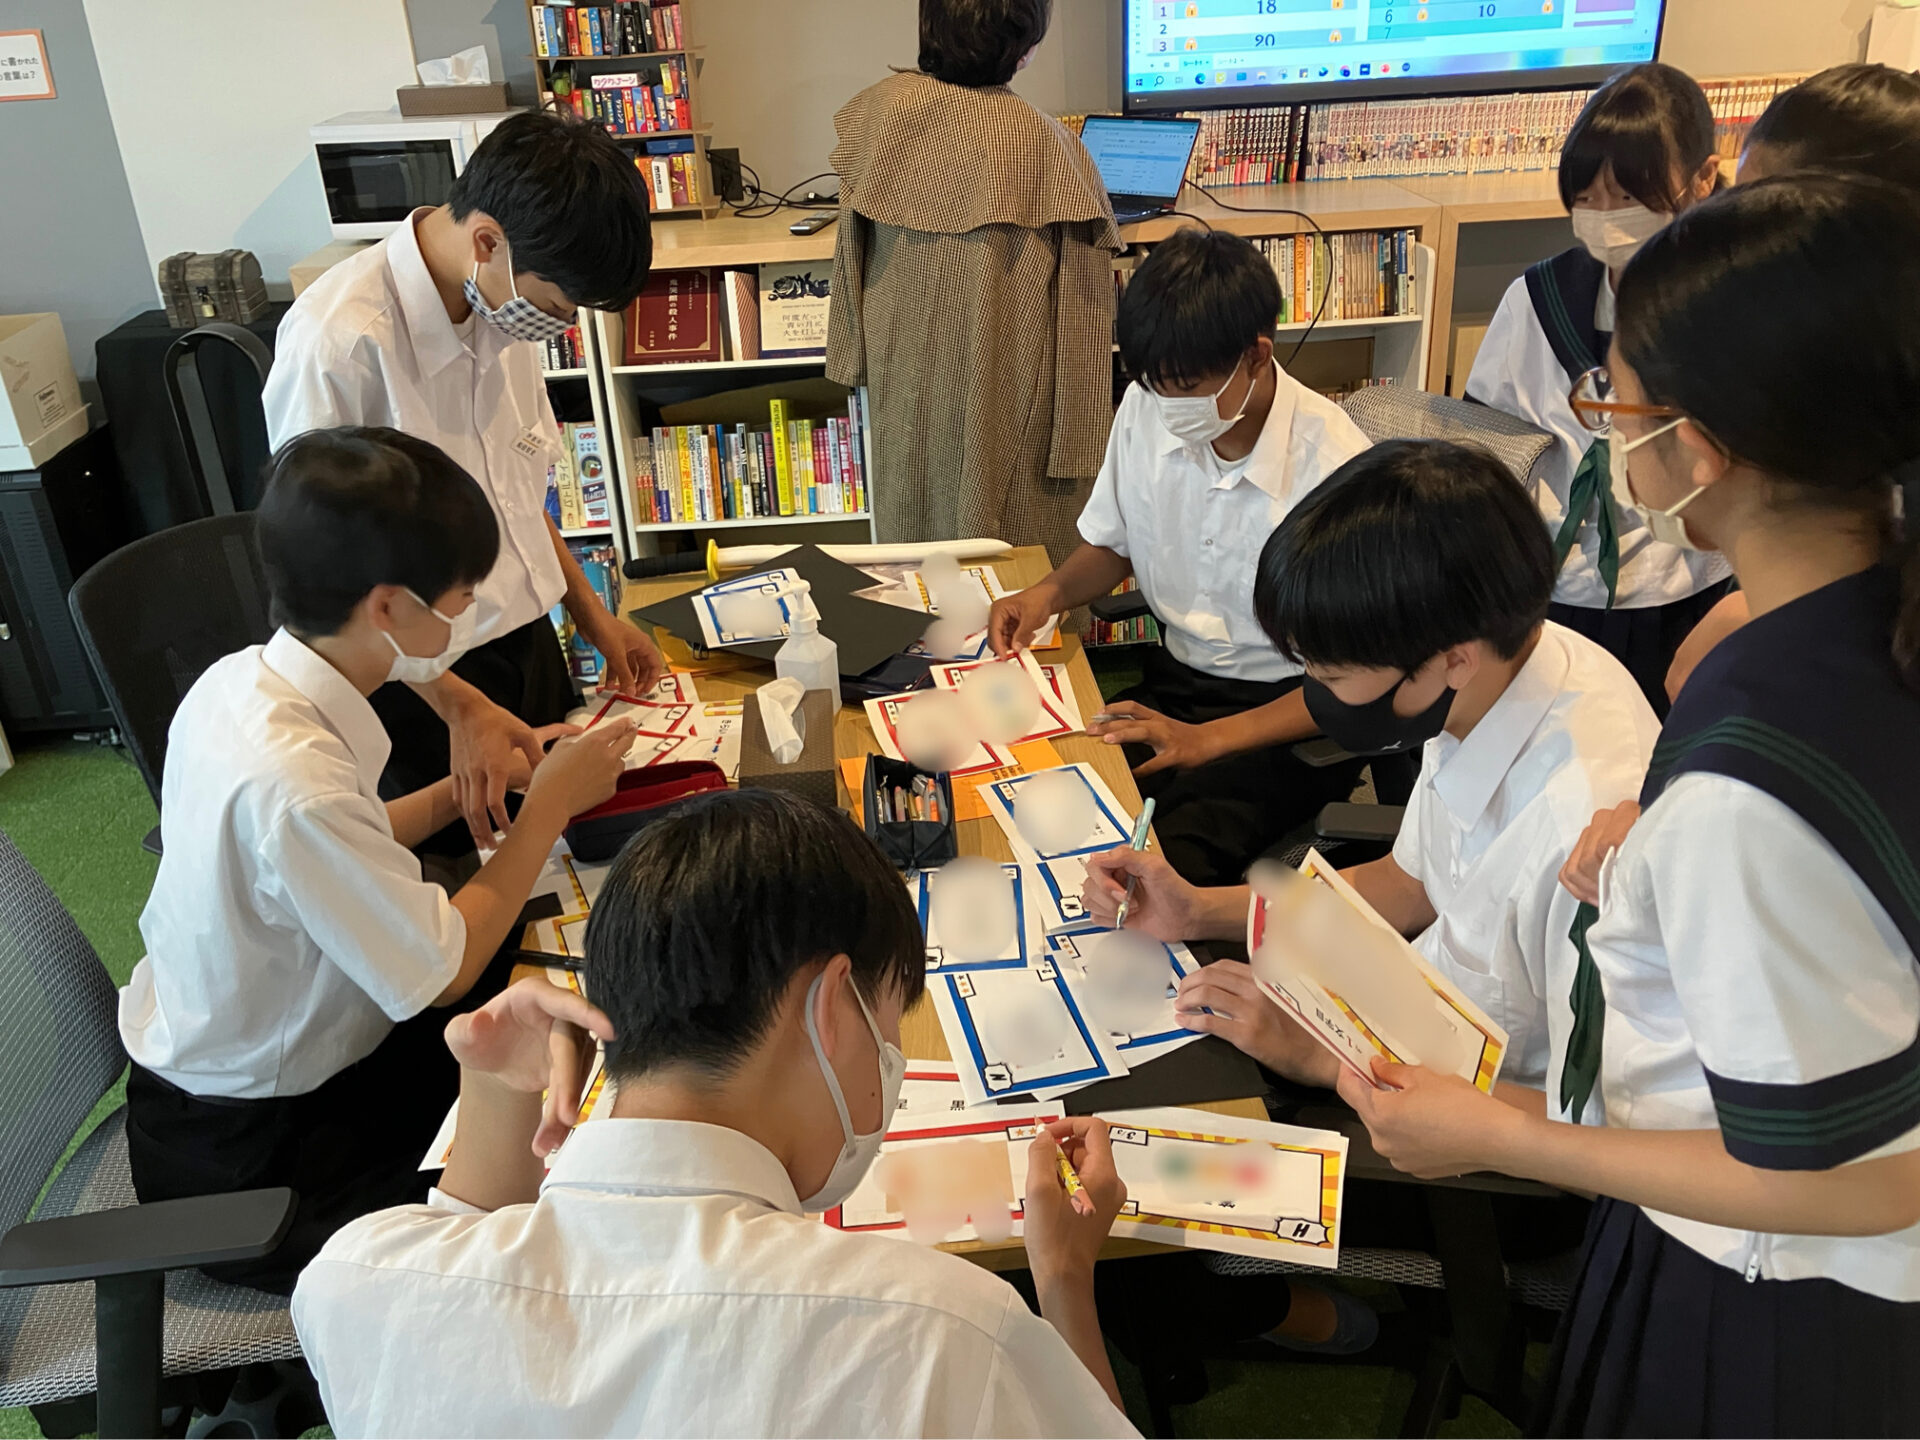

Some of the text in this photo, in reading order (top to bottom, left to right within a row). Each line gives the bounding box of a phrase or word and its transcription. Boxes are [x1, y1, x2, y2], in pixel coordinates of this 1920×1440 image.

[1160, 6, 1167, 17] 1
[1257, 0, 1277, 14] 18
[1479, 3, 1496, 18] 10
[1385, 9, 1393, 23] 6
[1160, 24, 1167, 35] 2
[1385, 27, 1392, 39] 7
[1159, 41, 1167, 52] 3
[1292, 1223, 1310, 1237] H
